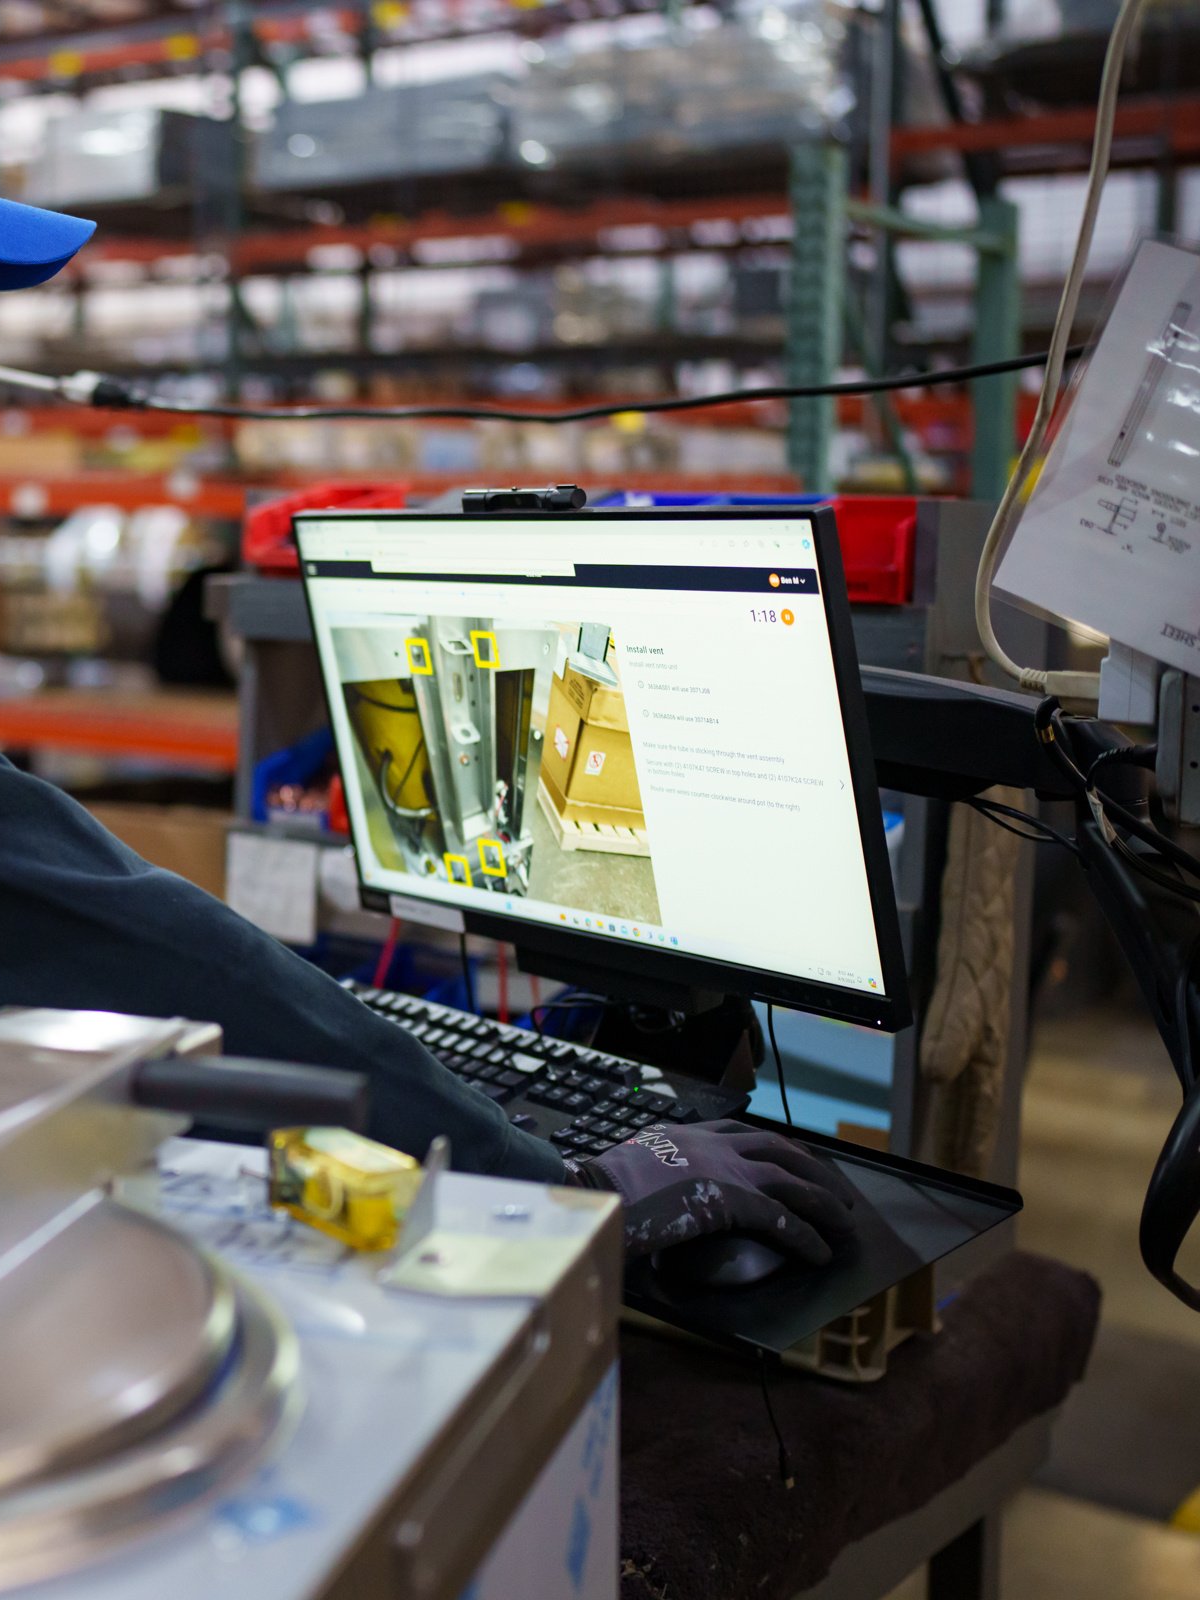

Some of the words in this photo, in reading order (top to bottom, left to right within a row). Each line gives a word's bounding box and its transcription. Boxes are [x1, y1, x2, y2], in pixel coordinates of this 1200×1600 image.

[750, 609, 777, 623] 1:18
[1160, 622, 1197, 648] SHEET
[626, 645, 648, 654] Install
[648, 647, 664, 655] vent
[695, 748, 715, 757] sticking
[715, 749, 736, 759] through
[759, 755, 785, 764] assembly
[706, 765, 725, 774] SCREW
[741, 769, 756, 778] holes
[757, 772, 768, 780] and
[768, 773, 777, 781] (2)
[802, 777, 824, 787] SCREW
[737, 797, 756, 805] around
[785, 803, 801, 812] right)
